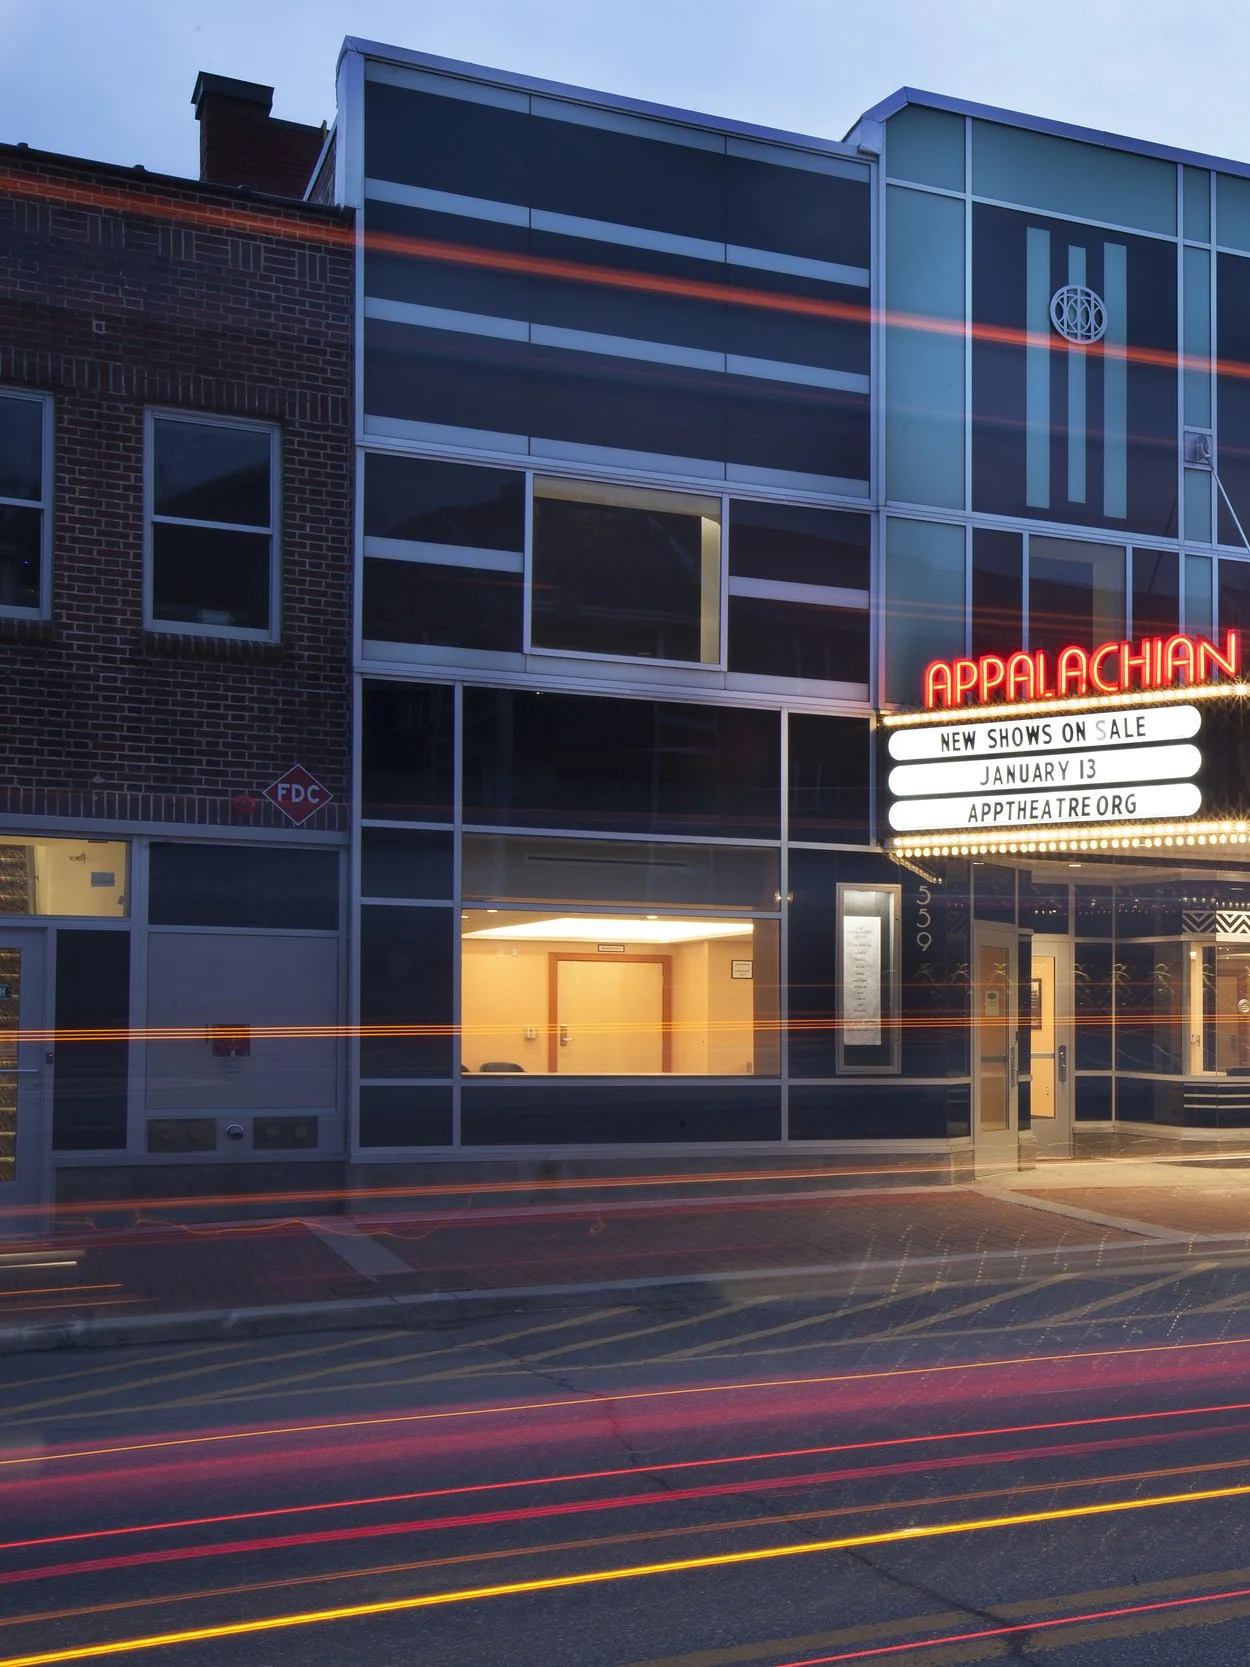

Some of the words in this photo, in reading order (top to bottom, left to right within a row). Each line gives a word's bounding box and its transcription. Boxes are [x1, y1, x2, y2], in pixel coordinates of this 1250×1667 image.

[925, 629, 1239, 709] APPALACHIAN
[940, 730, 976, 753] NEW
[987, 723, 1053, 750] SHOWS
[1062, 720, 1086, 743] ON
[1095, 716, 1147, 741] SALE
[980, 760, 1070, 786] JANUARY
[1079, 758, 1097, 780] 13
[277, 783, 321, 804] FDC
